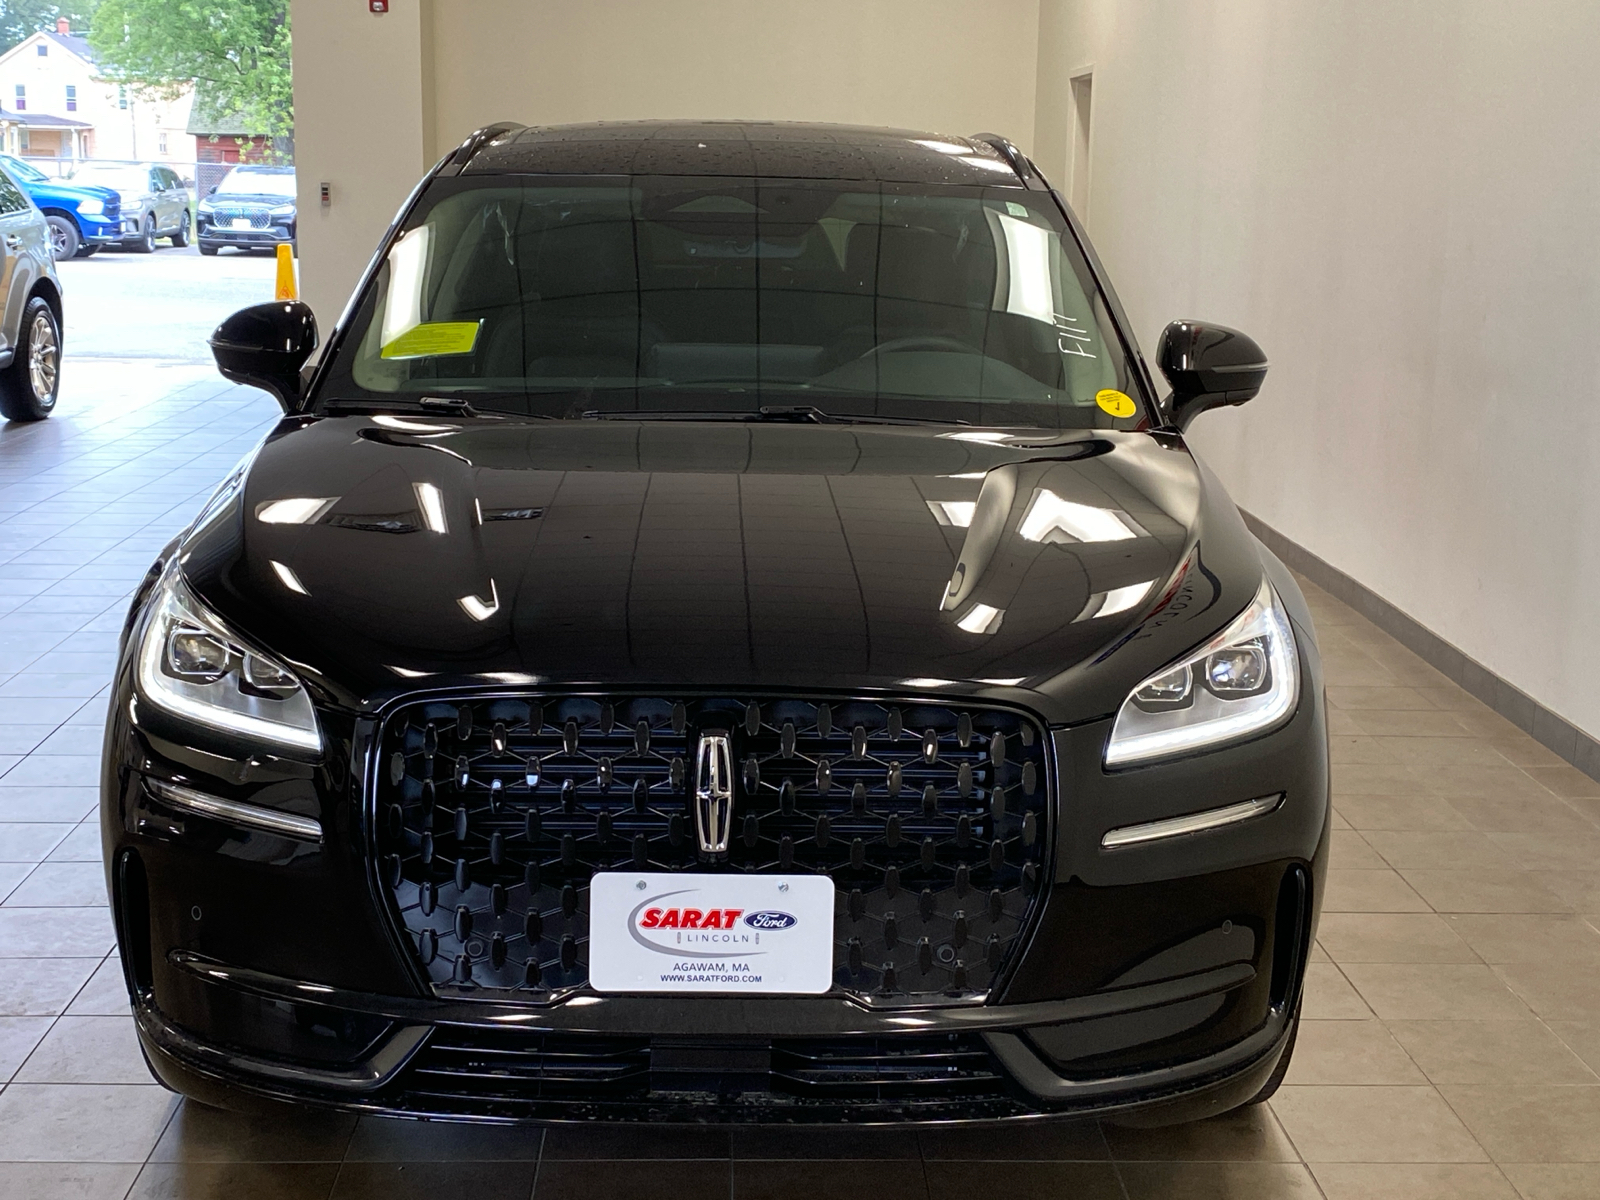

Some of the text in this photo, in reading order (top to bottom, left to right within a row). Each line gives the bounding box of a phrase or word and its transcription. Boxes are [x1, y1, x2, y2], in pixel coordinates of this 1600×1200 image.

[639, 907, 788, 930] SARAT Ford
[687, 934, 750, 943] LINCOLN
[673, 963, 750, 973] AGAWAM, MA
[660, 974, 762, 983] WWW.SARATFORD.COM
